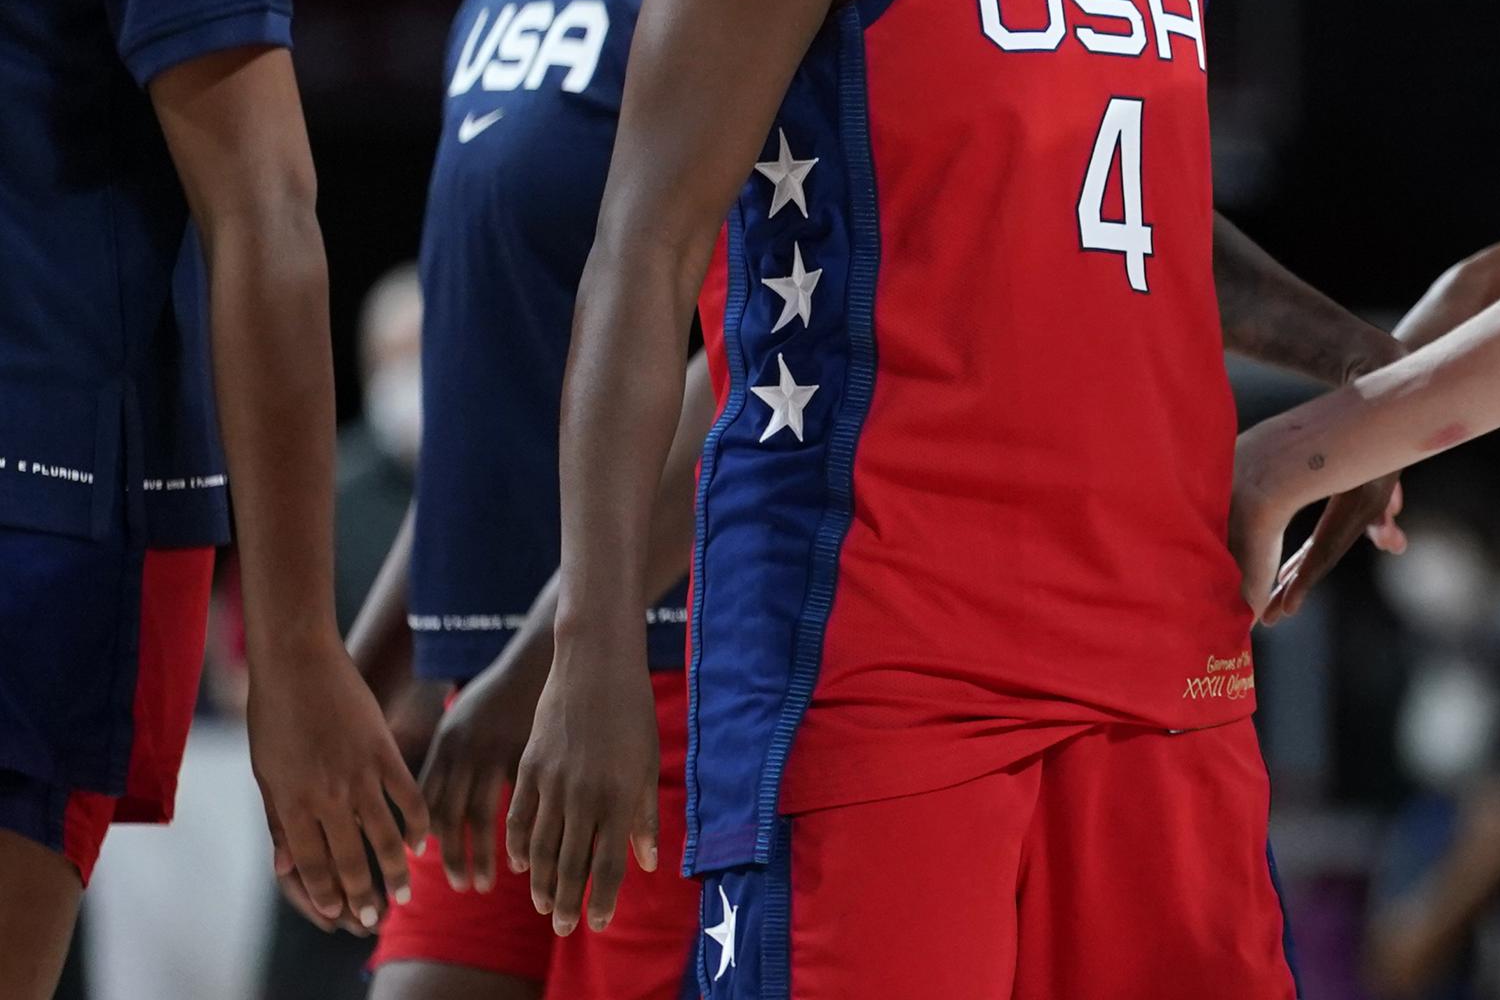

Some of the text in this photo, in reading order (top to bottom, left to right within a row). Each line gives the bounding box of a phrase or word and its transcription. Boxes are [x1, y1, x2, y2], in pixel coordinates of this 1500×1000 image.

[447, 0, 610, 99] USA
[1075, 95, 1154, 295] 4
[18, 460, 27, 472] E
